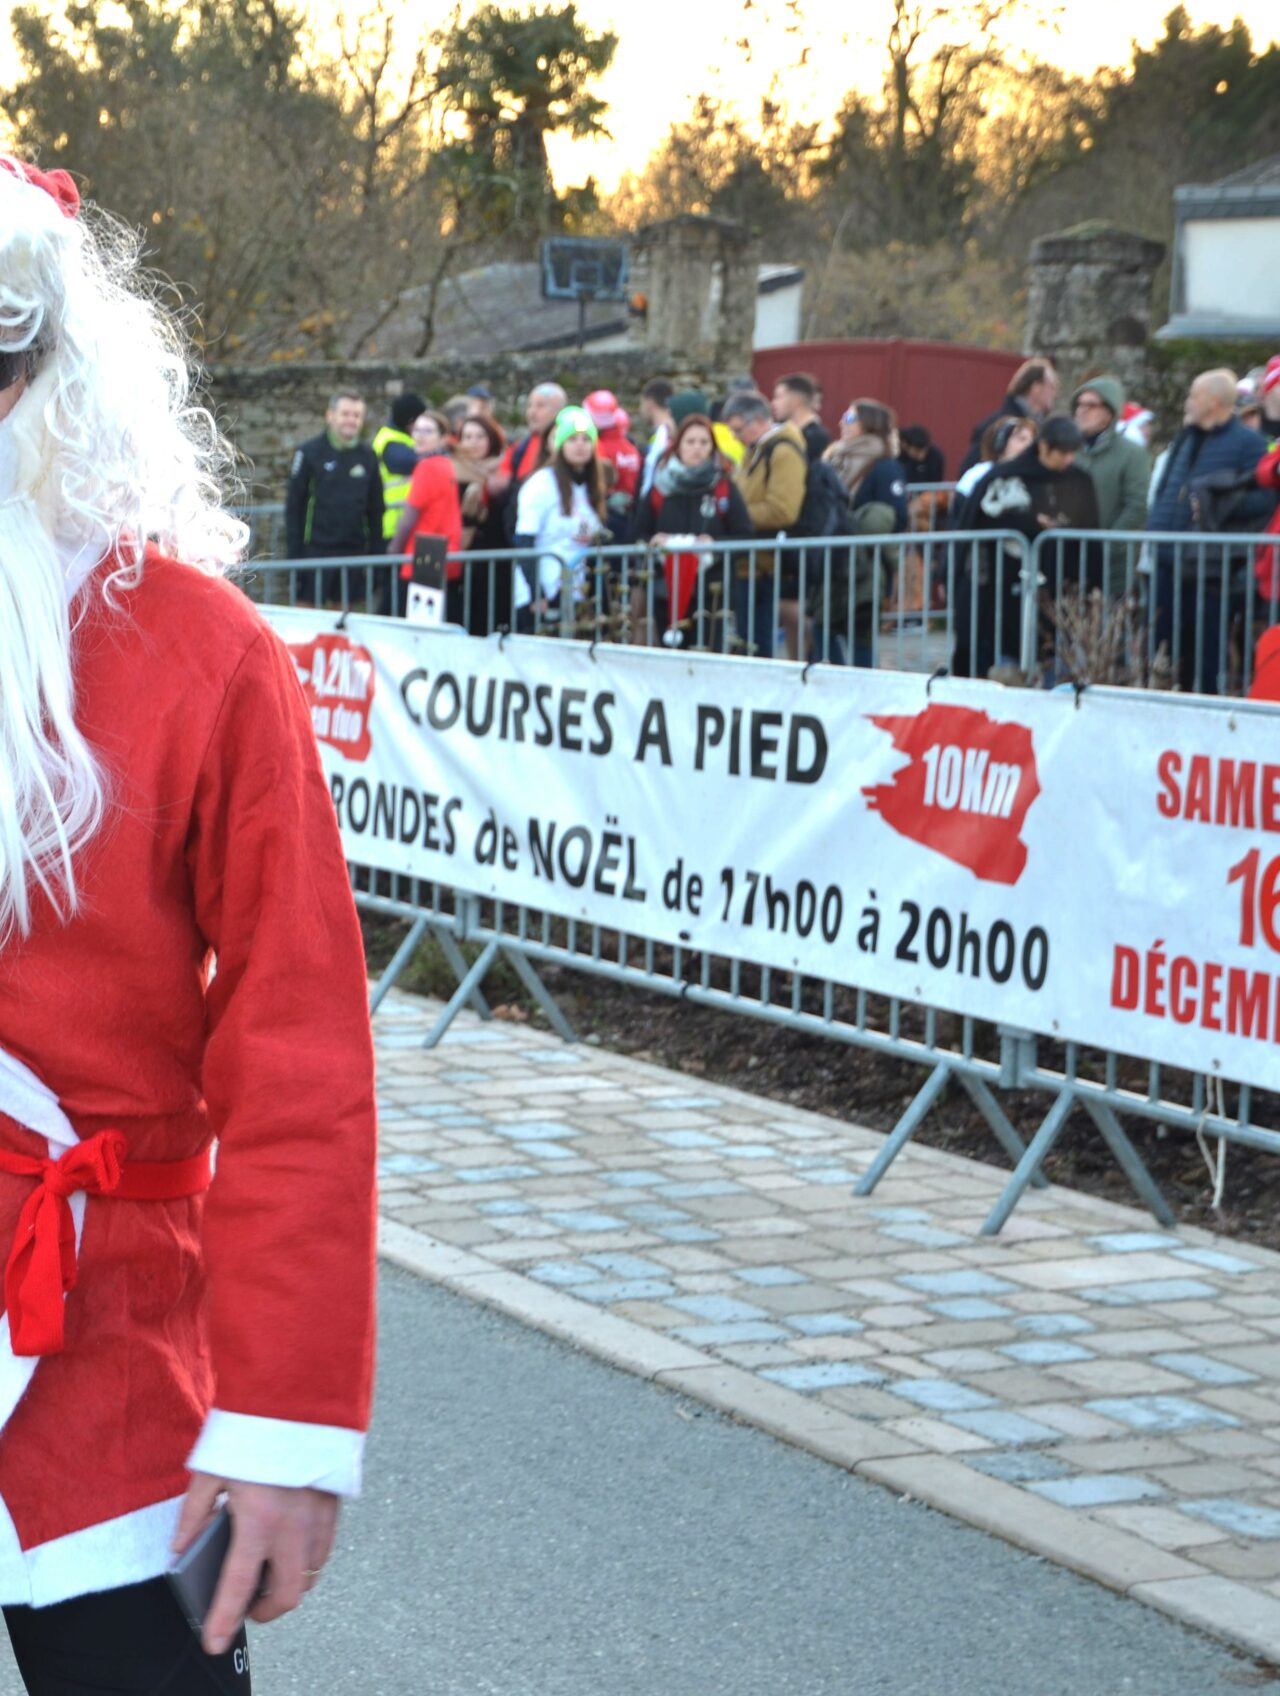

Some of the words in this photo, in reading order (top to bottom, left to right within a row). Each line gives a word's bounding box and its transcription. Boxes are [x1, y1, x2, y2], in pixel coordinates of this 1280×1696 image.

[401, 667, 616, 756] COURSES
[634, 698, 673, 766] A
[694, 704, 828, 785] PIED
[922, 744, 1022, 819] 10Km
[1156, 748, 1280, 834] SAME
[331, 772, 462, 855] RONDES
[475, 806, 519, 870] de
[528, 814, 647, 903] NOËL
[662, 857, 703, 916] de
[720, 867, 843, 944] 17h00
[857, 888, 880, 953] à
[894, 900, 1049, 992] 20h00
[1226, 847, 1280, 956] 16
[1109, 938, 1280, 1046] DÉCEM
